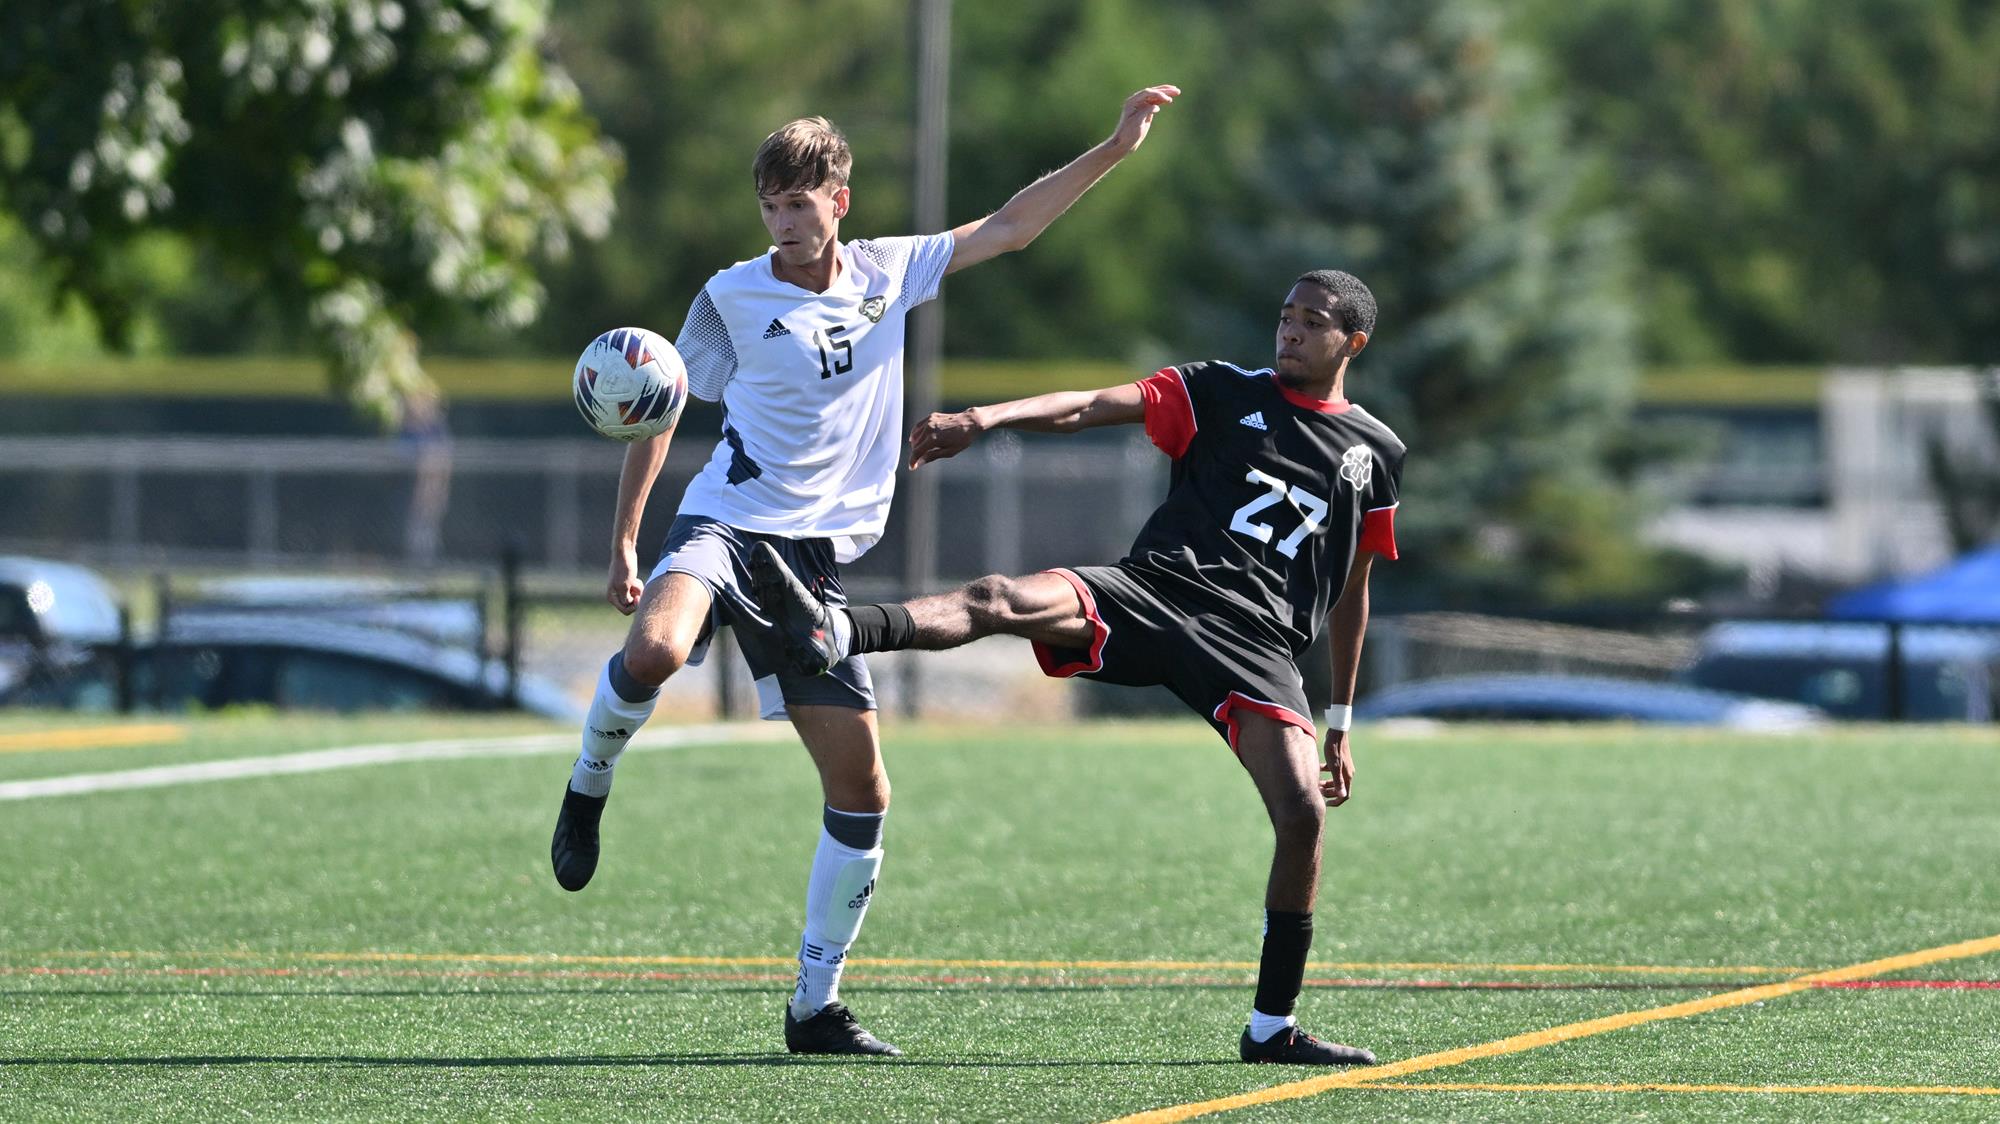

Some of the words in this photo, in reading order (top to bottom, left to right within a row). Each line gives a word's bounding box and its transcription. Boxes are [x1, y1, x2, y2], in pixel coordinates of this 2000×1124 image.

[763, 327, 791, 339] adidas
[813, 325, 852, 379] 15
[1240, 418, 1267, 430] adidas
[1230, 469, 1328, 560] 27
